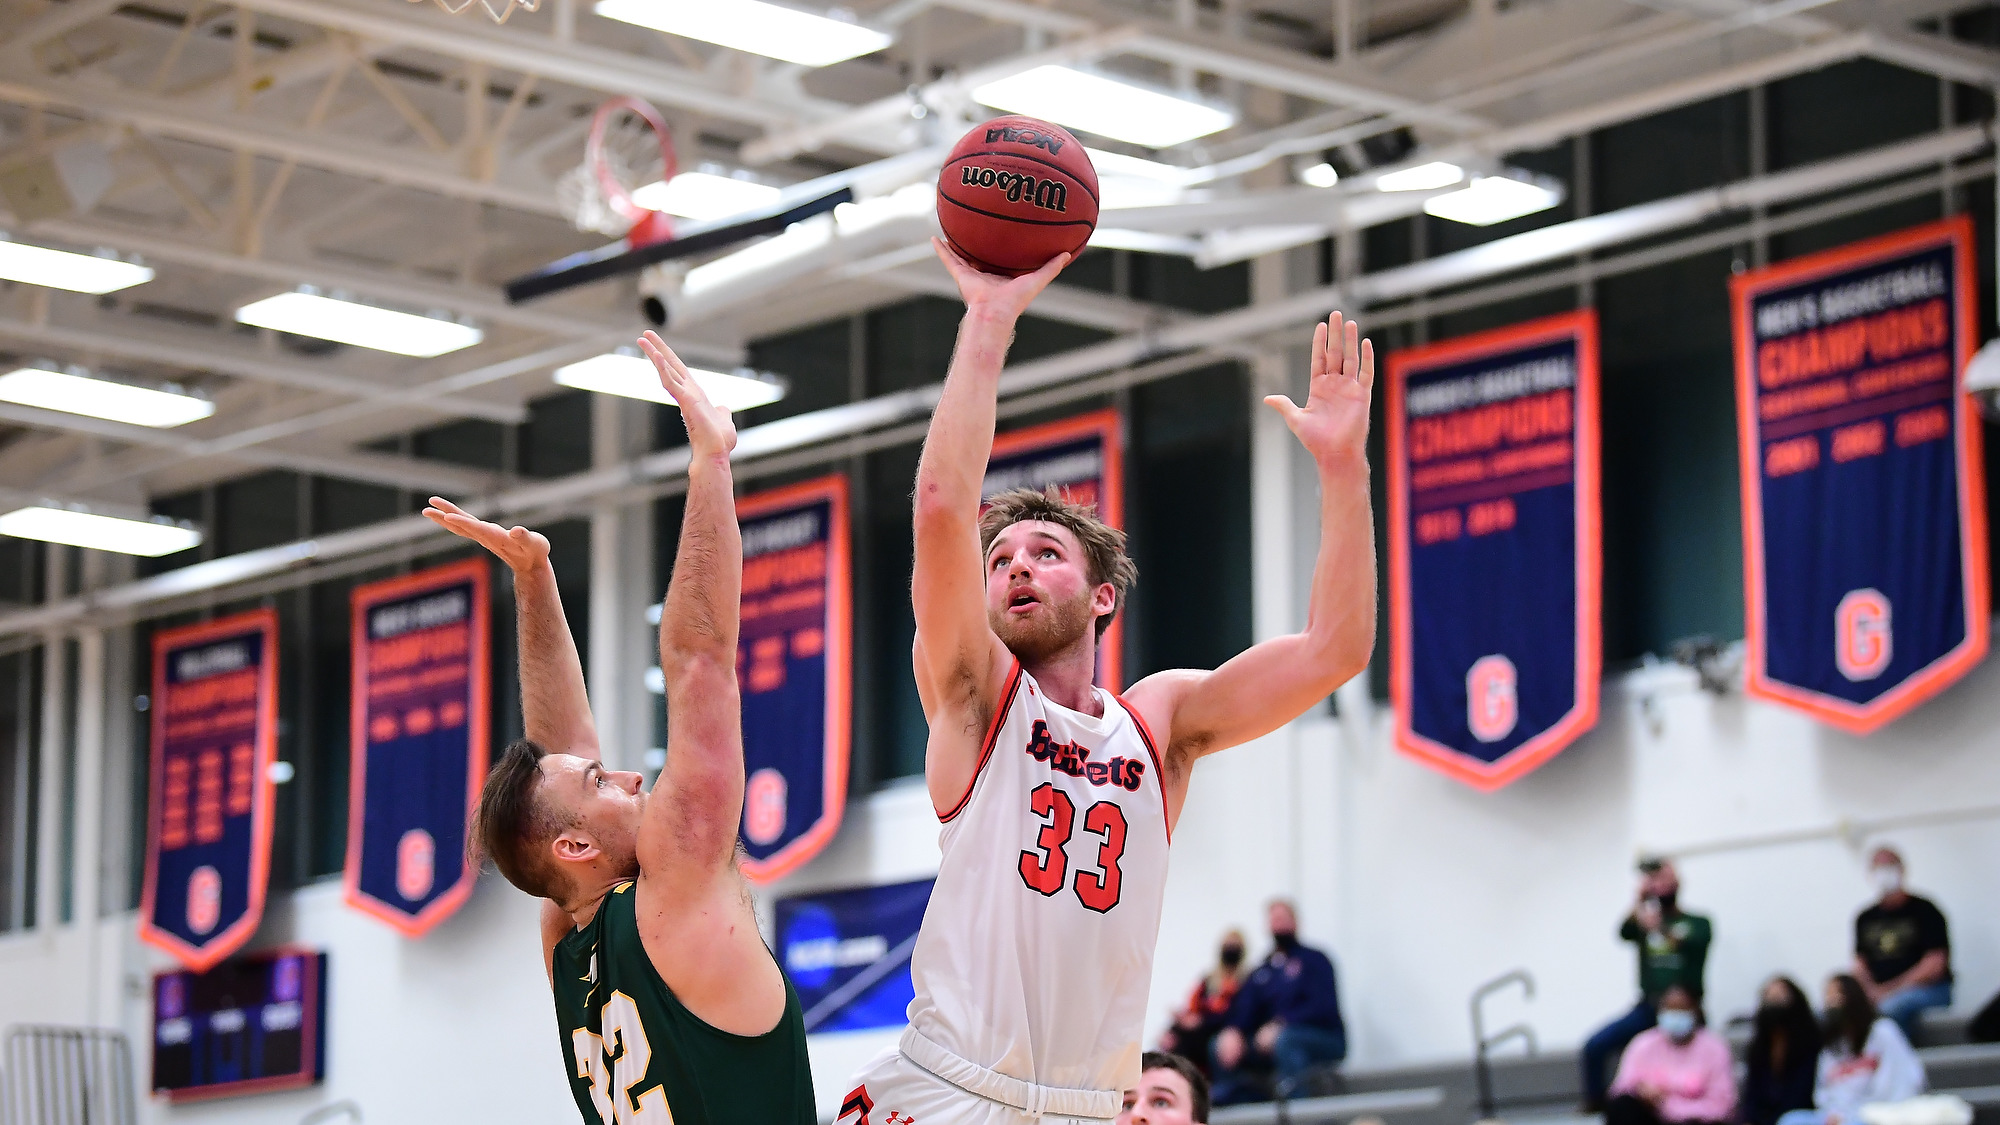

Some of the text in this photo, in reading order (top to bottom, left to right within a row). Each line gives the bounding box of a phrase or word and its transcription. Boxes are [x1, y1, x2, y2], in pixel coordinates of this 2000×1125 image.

[985, 127, 1065, 155] NCAA
[961, 165, 1067, 213] Wilson
[1758, 297, 1948, 389] CHAMPIONS
[1834, 587, 1893, 682] G
[1465, 653, 1519, 742] G
[1017, 781, 1129, 914] 33
